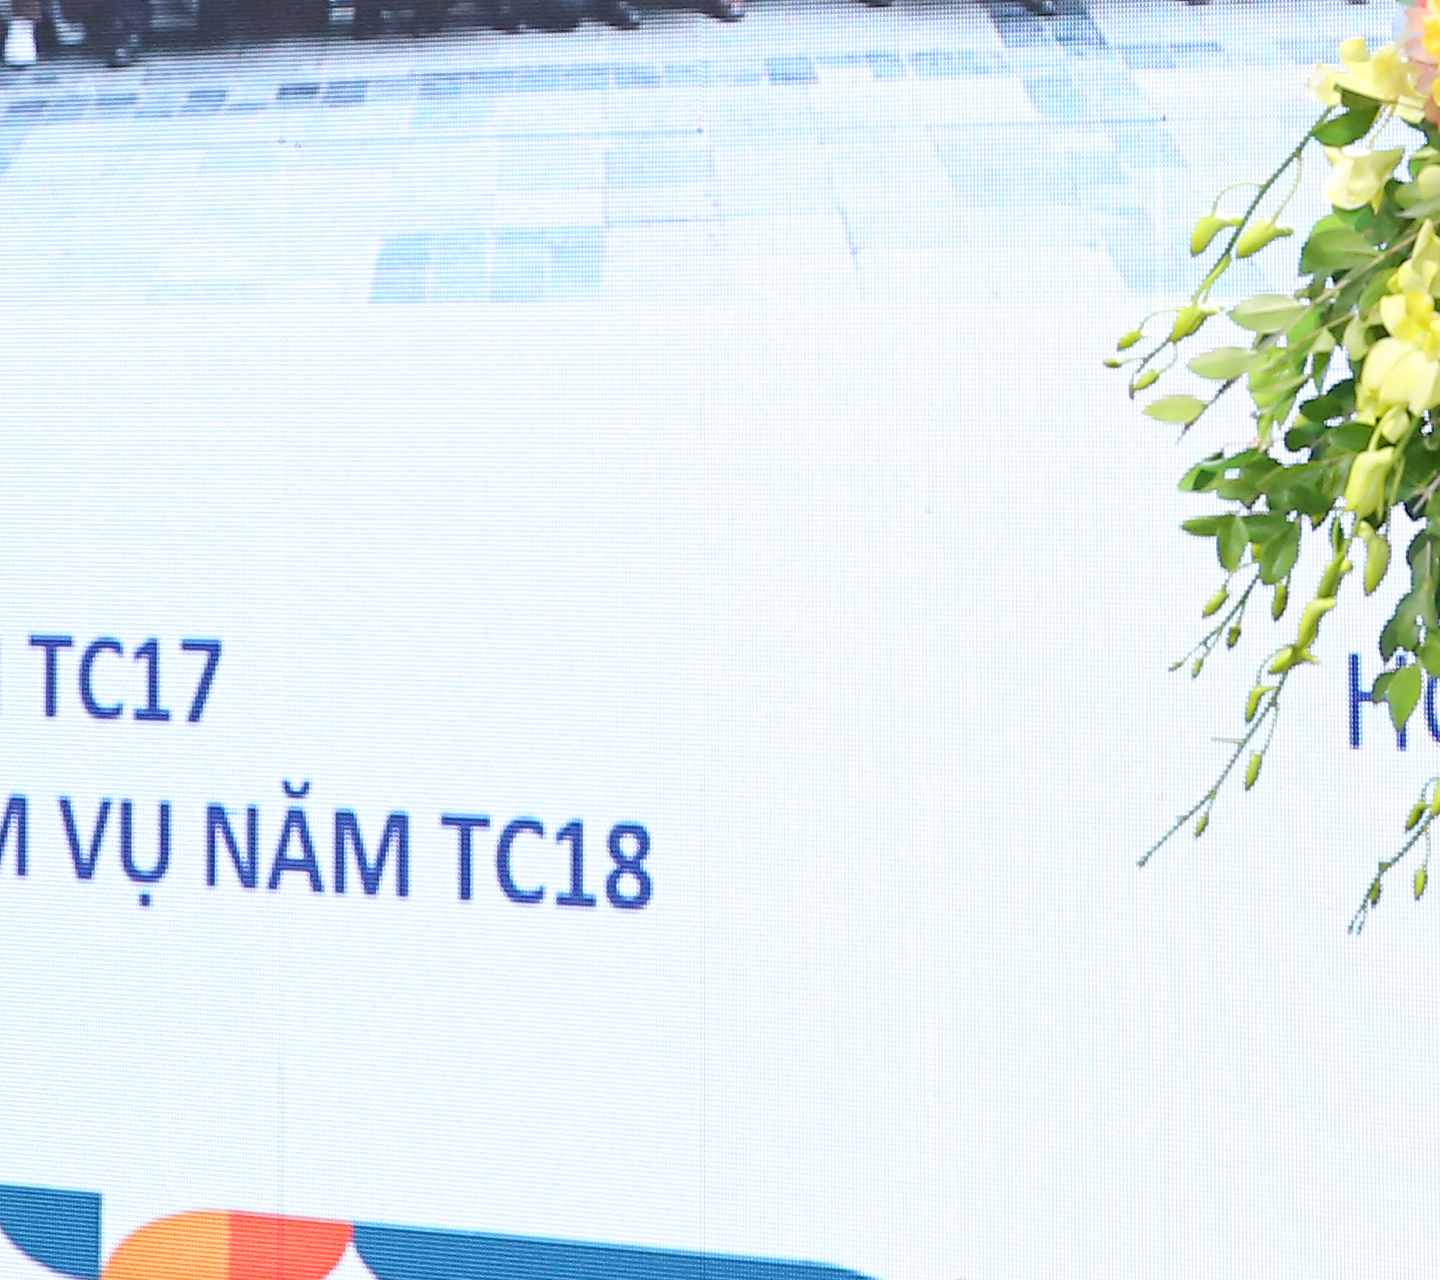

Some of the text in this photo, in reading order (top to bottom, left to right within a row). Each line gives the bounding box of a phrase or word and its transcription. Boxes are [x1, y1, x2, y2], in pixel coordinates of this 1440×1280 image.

[29, 634, 223, 723] TC17
[59, 794, 172, 907] VỤ
[205, 778, 410, 900] NĂM
[441, 812, 654, 910] TC18
